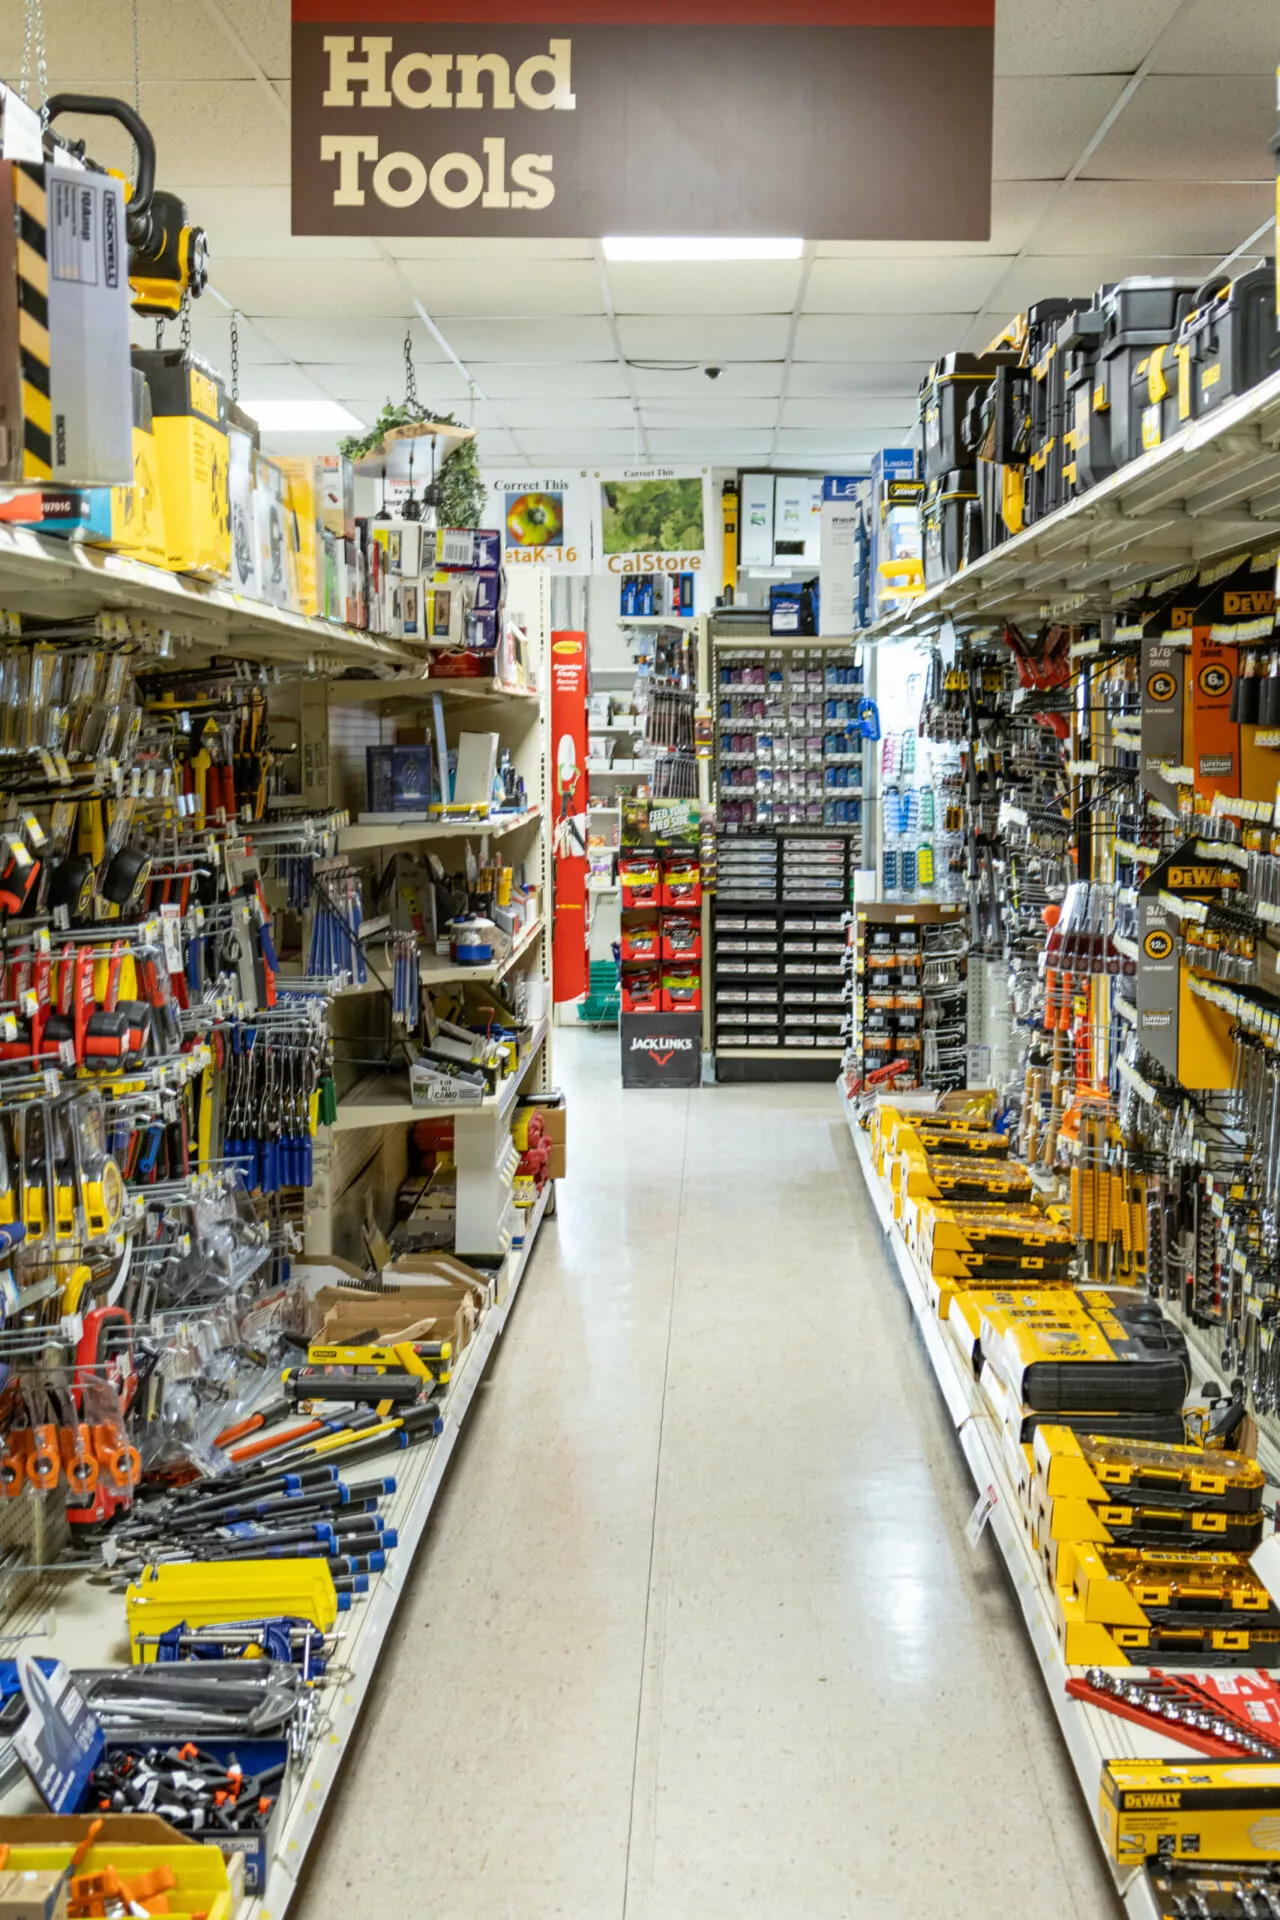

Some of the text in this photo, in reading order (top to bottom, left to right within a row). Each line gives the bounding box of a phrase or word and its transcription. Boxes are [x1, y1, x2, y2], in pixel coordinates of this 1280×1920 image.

[323, 36, 576, 110] Hand
[320, 135, 555, 210] Tools
[106, 196, 116, 281] ROCKWELL
[624, 468, 675, 478] Correct This
[494, 479, 569, 491] Correct This
[504, 547, 577, 563] etaK-16
[607, 553, 701, 573] CalStore
[1149, 658, 1170, 667] DRIVE
[1146, 916, 1166, 926] DRIVE
[630, 1037, 659, 1051] JACK
[1124, 1792, 1182, 1809] DEWALT
